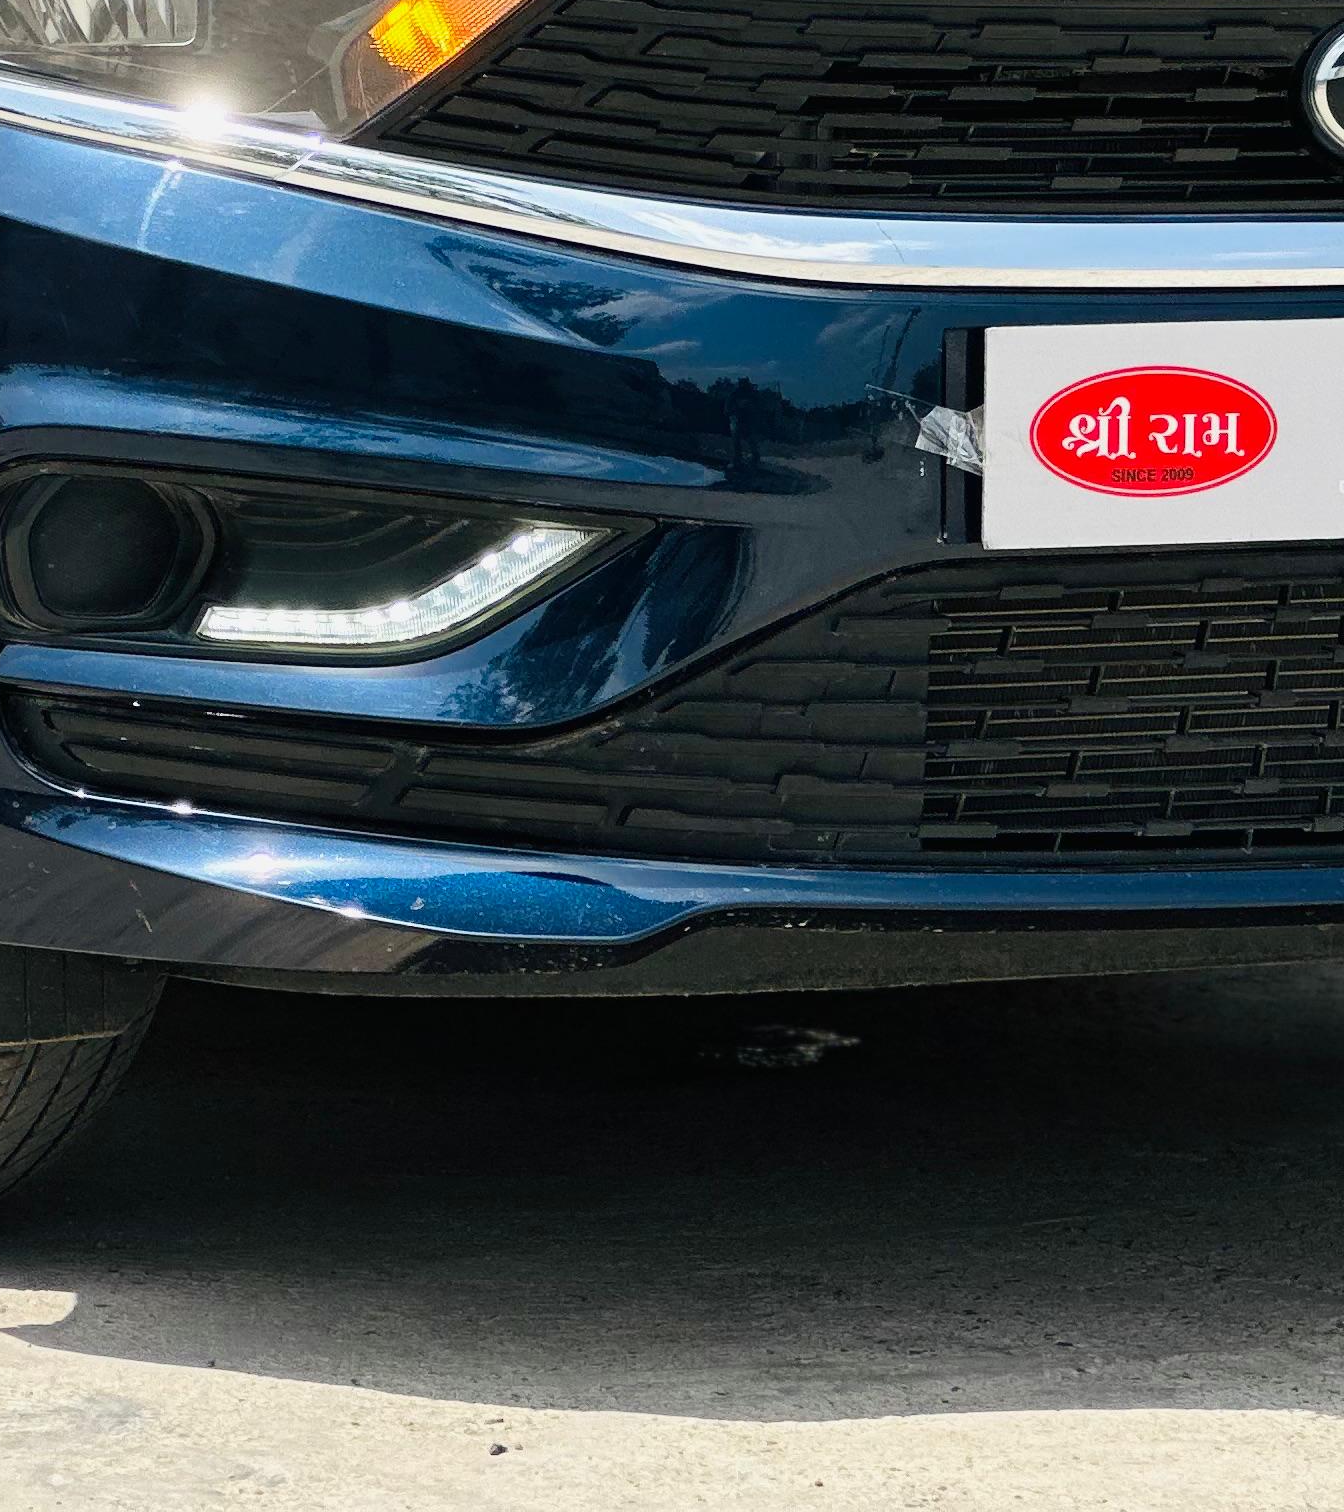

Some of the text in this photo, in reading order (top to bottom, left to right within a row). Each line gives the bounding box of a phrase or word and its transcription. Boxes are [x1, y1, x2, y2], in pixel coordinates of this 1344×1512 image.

[1061, 396, 1245, 460] શ્રી રામ
[1111, 466, 1195, 483] SINCE 2009
